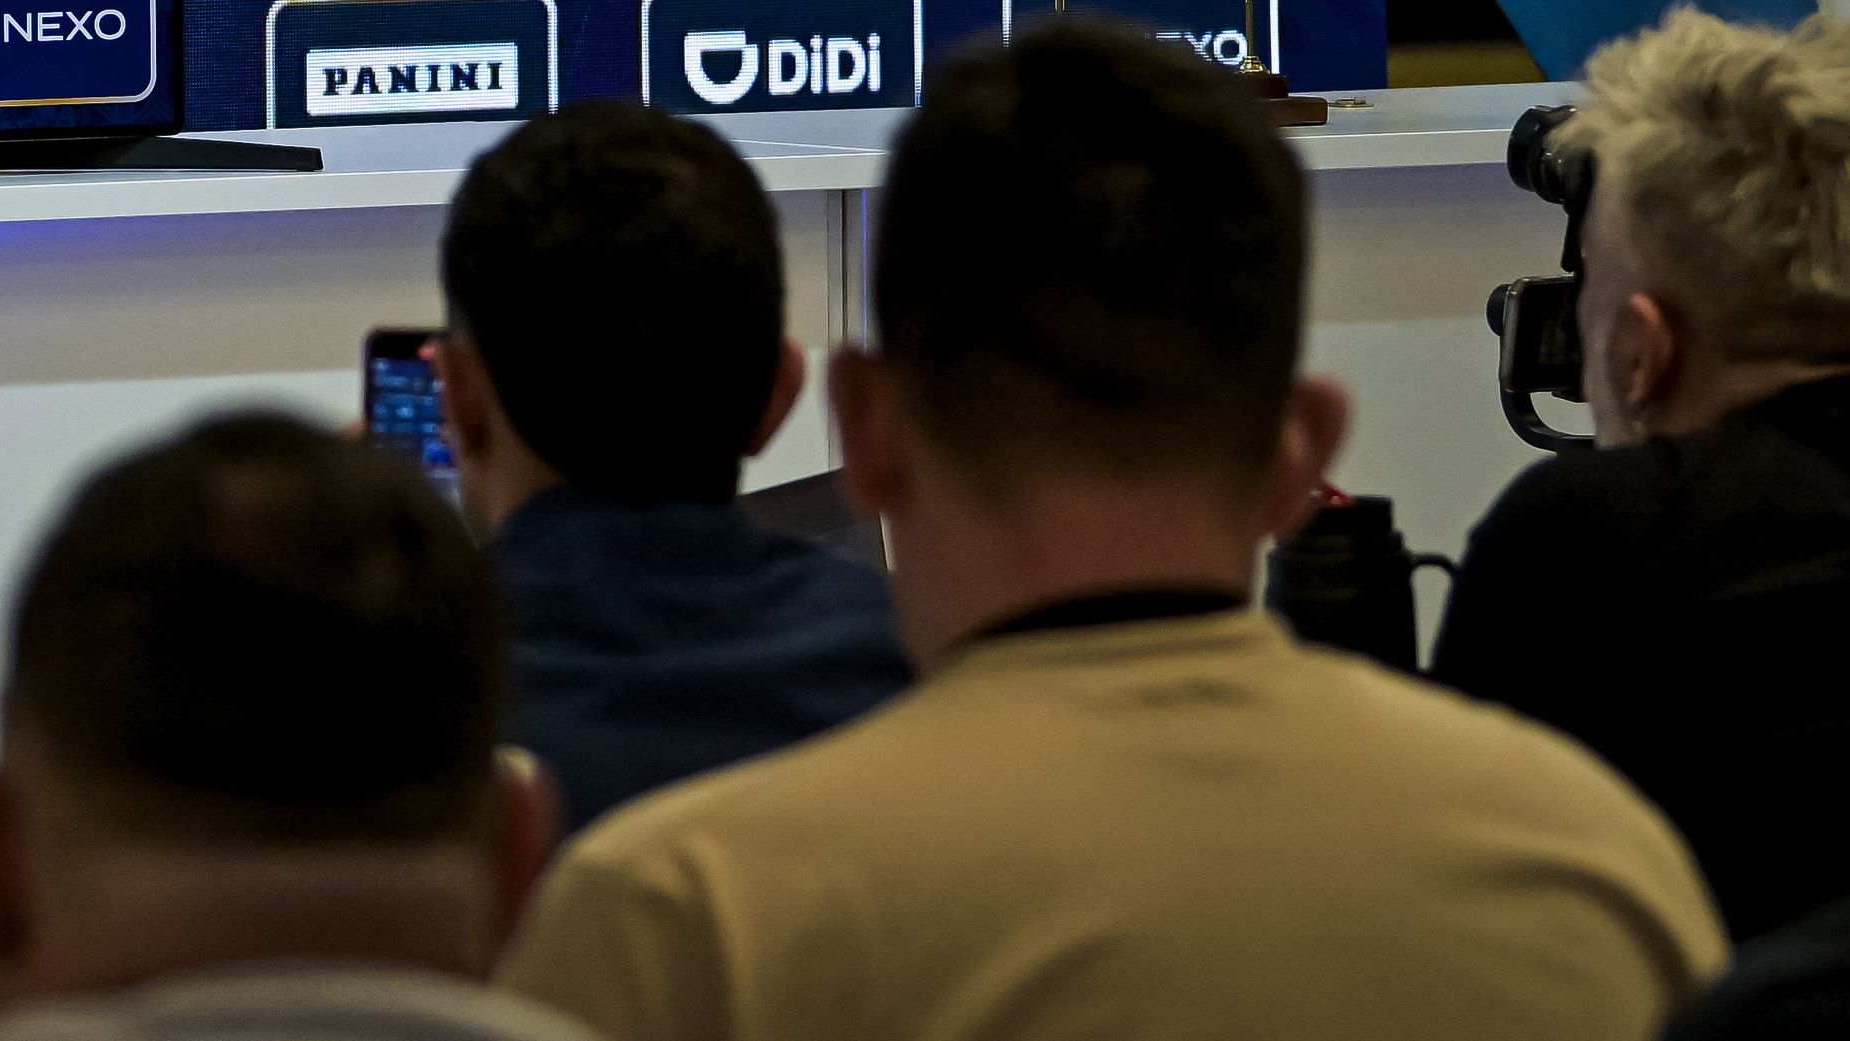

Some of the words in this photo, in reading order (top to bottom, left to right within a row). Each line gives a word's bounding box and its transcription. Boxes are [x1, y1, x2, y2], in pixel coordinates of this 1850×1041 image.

[3, 9, 126, 42] NEXO
[324, 62, 500, 96] PANINI
[769, 34, 880, 95] DiDi
